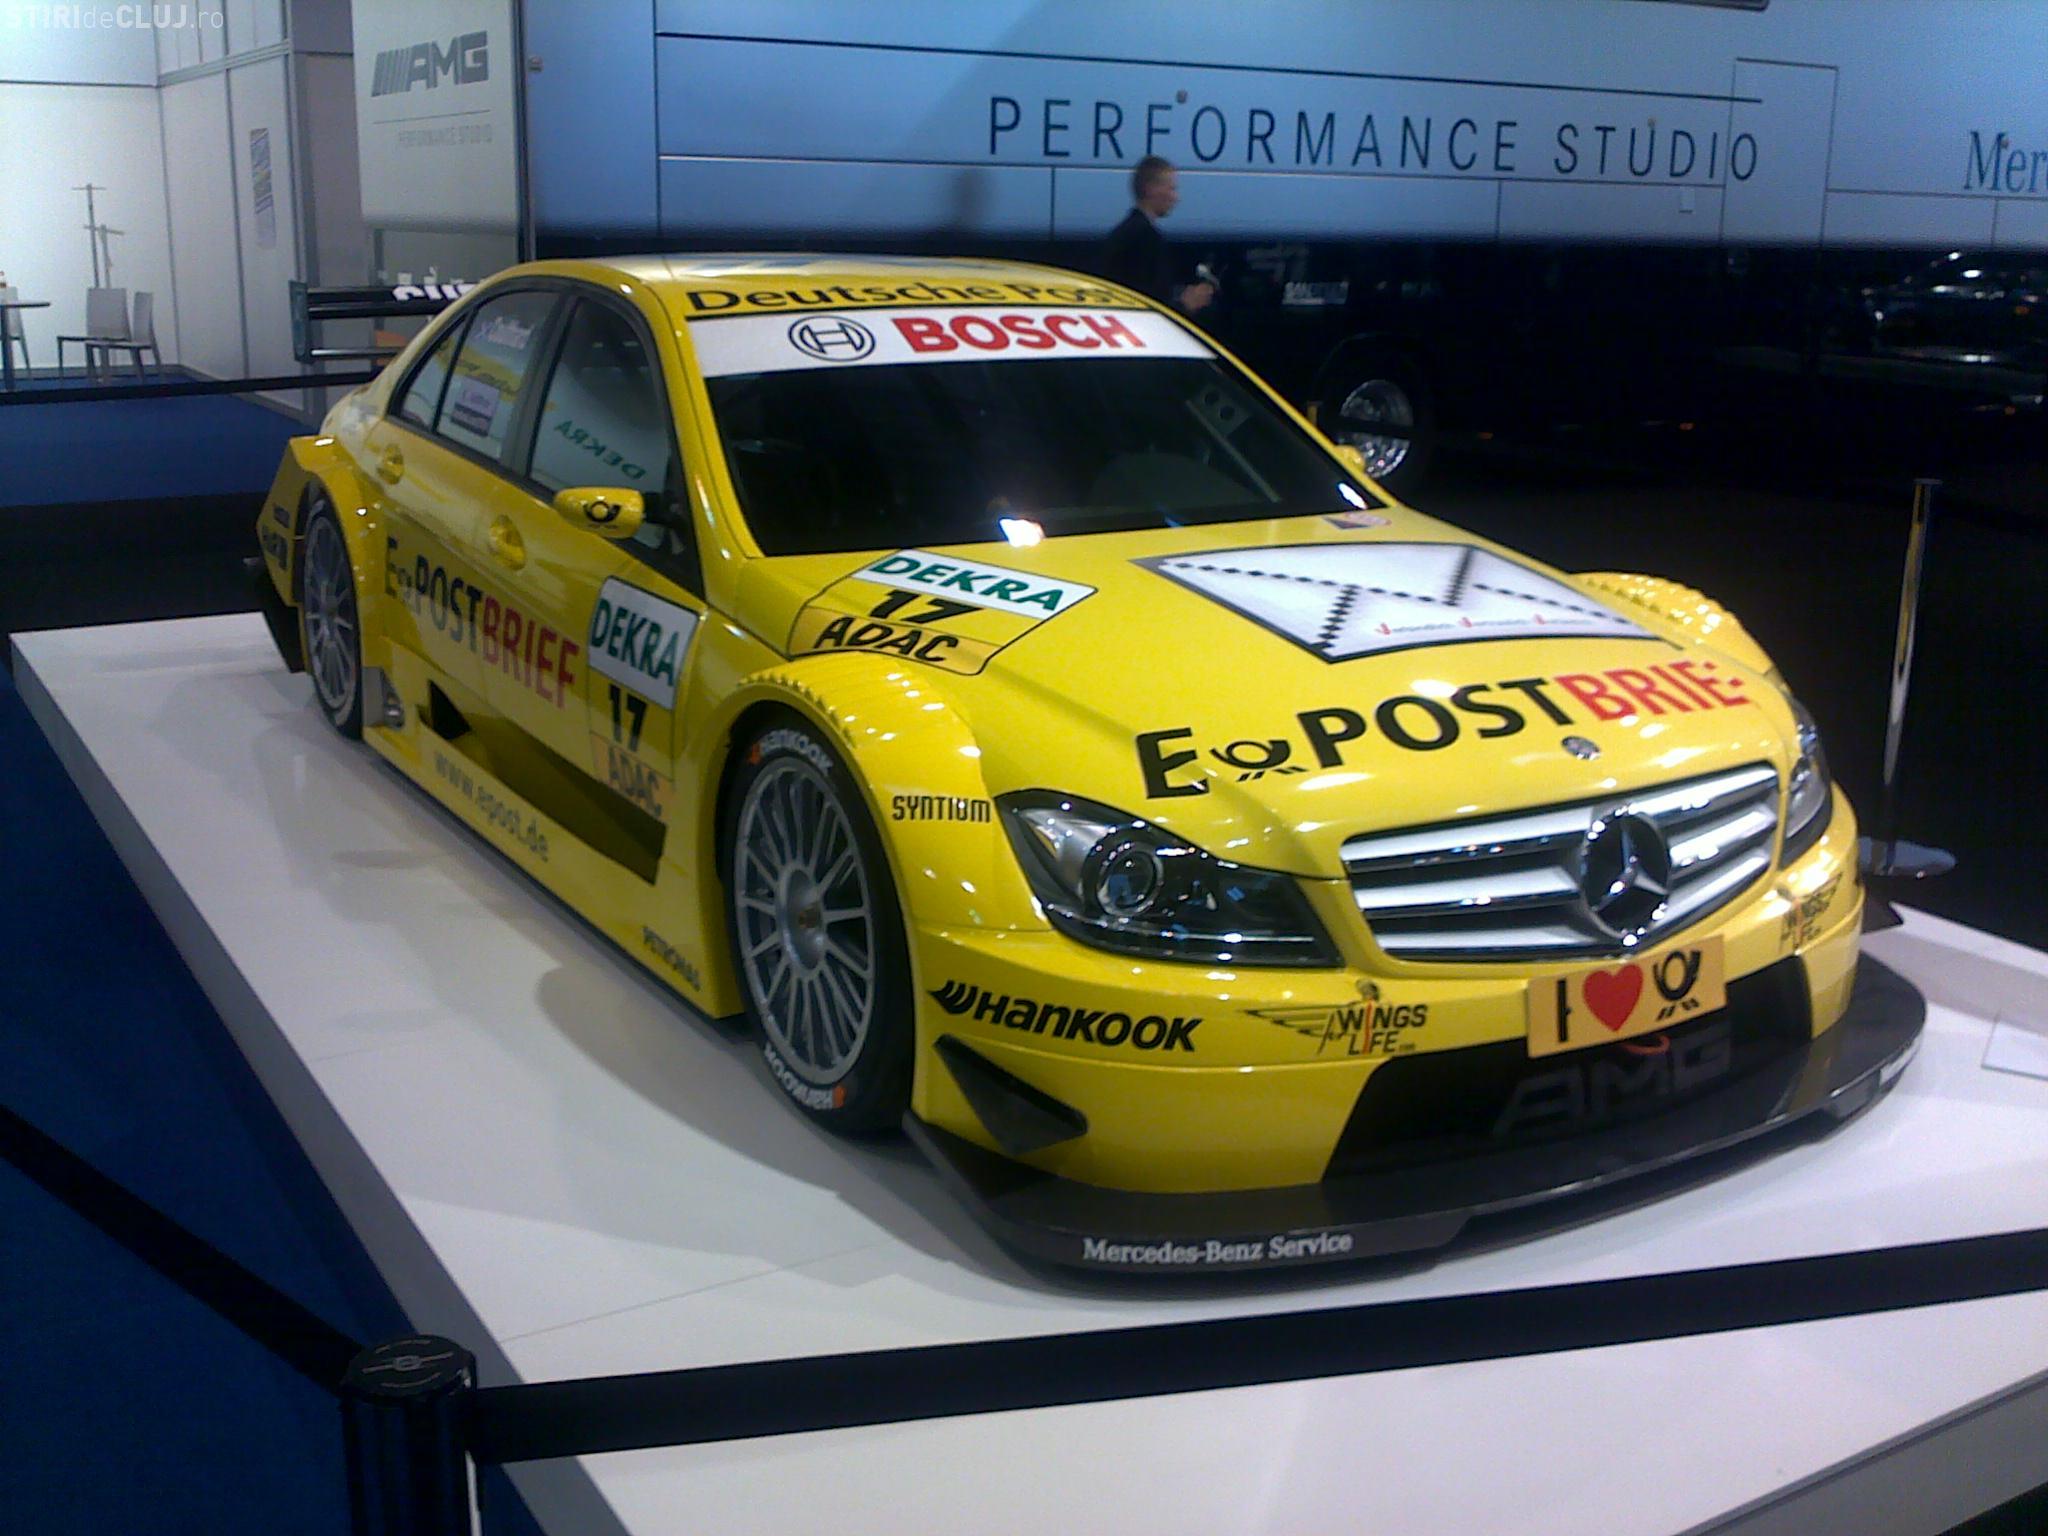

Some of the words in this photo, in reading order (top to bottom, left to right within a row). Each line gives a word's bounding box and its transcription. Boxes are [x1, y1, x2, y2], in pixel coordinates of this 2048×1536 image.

[404, 30, 489, 91] AMG
[989, 96, 1518, 172] PERFORMANCE
[1554, 123, 1758, 181] STUDIO
[1963, 130, 2048, 193] Mer
[686, 282, 1005, 311] Deutsche
[891, 314, 1146, 353] BOSCH
[869, 556, 1064, 611] DEKRA
[869, 589, 985, 624] 17
[590, 598, 680, 687] DEKRA
[813, 616, 960, 662] ADAC
[609, 683, 648, 752] 17
[1297, 660, 1753, 769] POSTBRIE
[1082, 1238, 1263, 1264] Mercedes-Benz
[1268, 1233, 1354, 1259] Service
